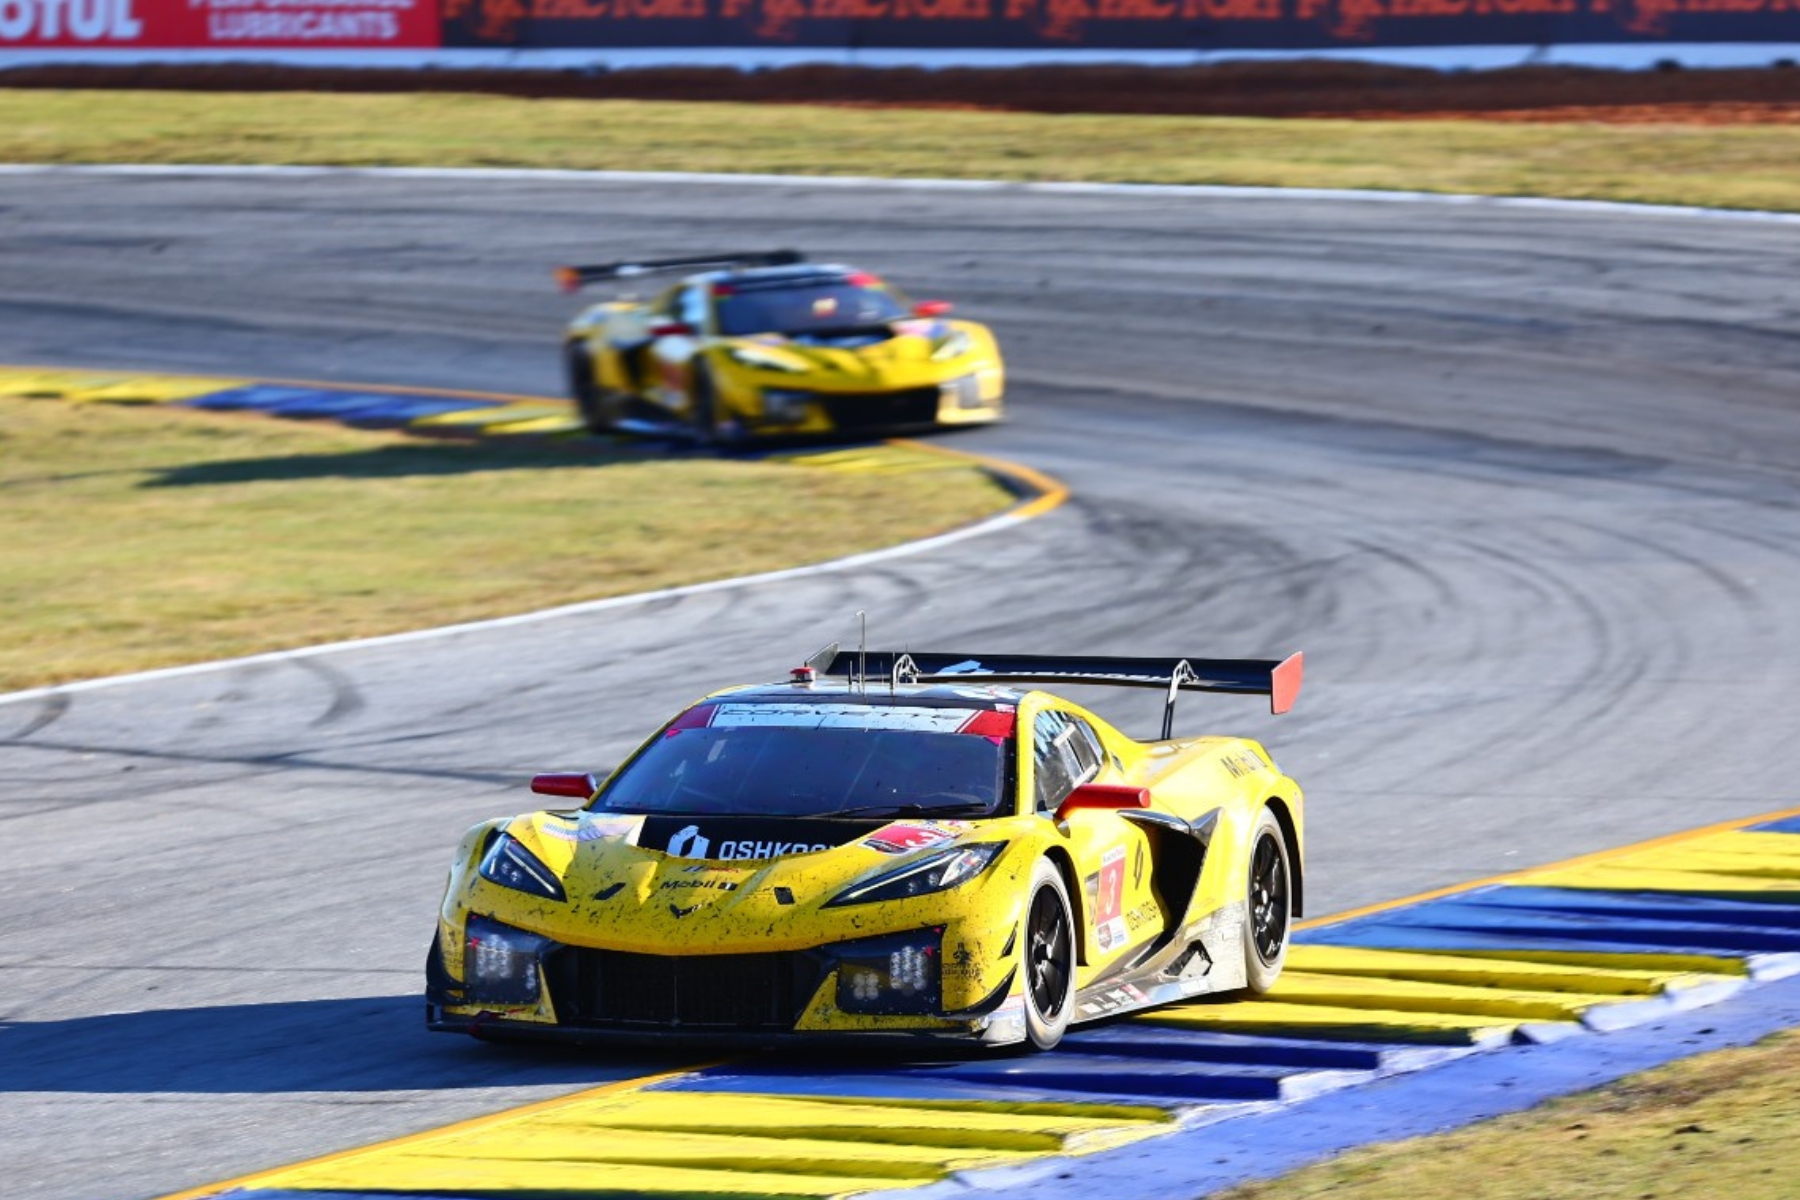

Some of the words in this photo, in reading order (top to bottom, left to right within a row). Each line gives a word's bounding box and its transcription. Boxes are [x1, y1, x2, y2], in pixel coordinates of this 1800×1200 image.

[208, 11, 398, 40] LUBRICANTS
[719, 840, 836, 860] OSHKO
[660, 879, 715, 890] Mobil
[1105, 868, 1118, 916] 3
